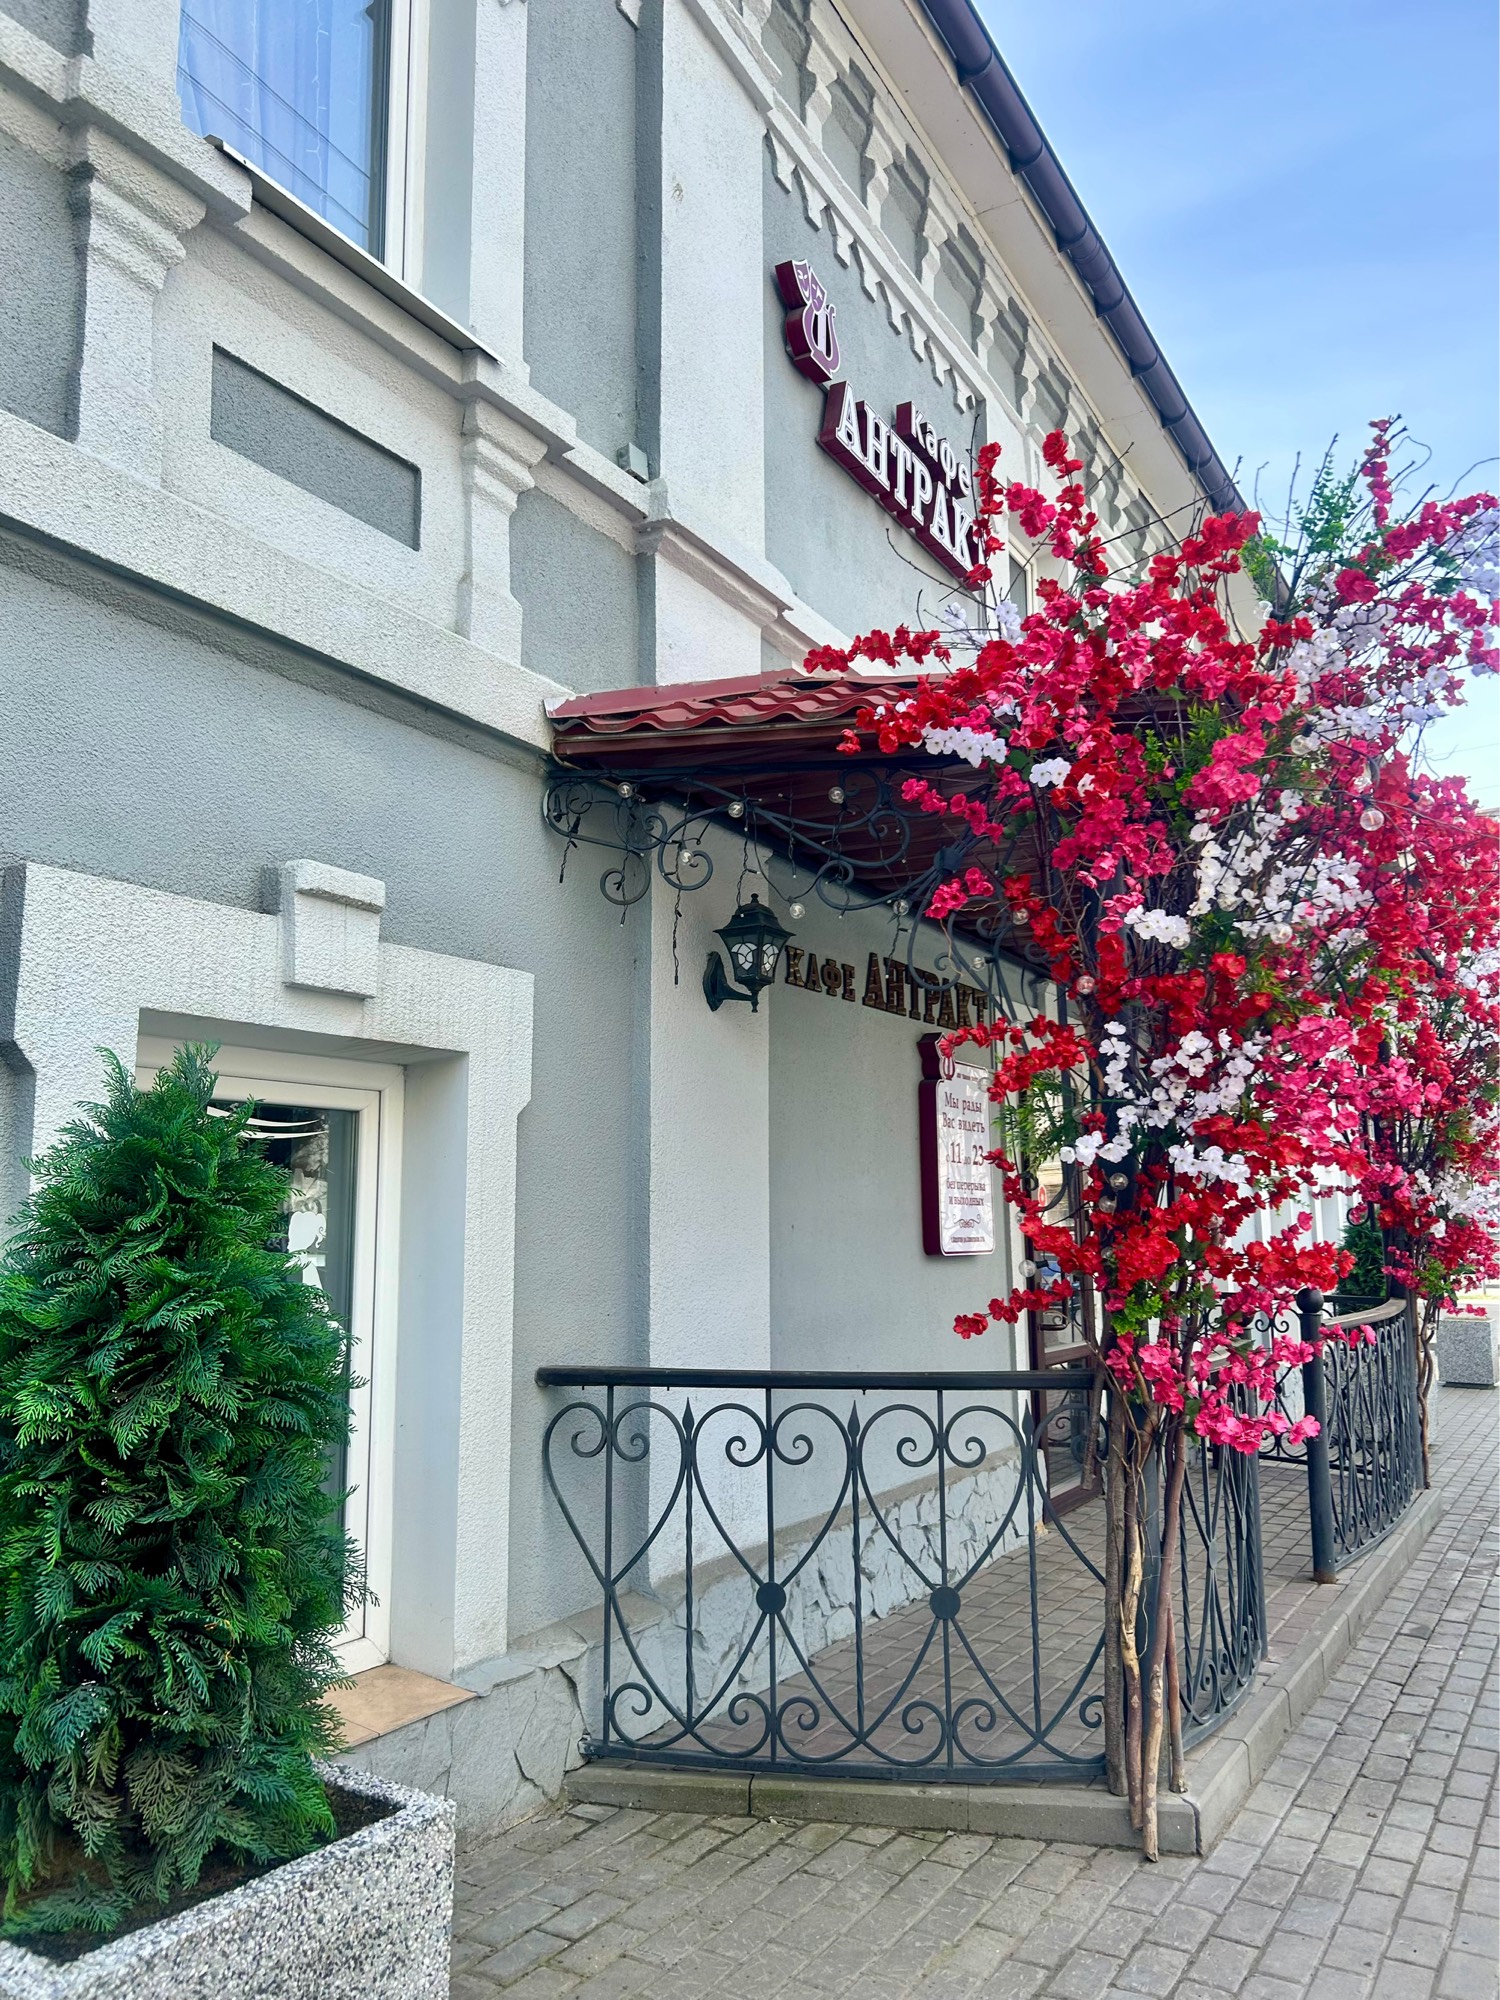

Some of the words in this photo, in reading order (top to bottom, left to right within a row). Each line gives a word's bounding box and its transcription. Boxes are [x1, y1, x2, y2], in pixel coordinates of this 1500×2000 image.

[910, 403, 971, 497] кафе
[785, 945, 855, 1002] КАФЕ
[862, 952, 989, 1030] АНТРАКТ
[944, 1092, 959, 1109] Мы
[962, 1099, 982, 1114] рады
[942, 1112, 955, 1128] Вас
[958, 1118, 985, 1133] видеть
[950, 1142, 962, 1164] 11
[972, 1144, 984, 1167] 23
[946, 1177, 955, 1190] без
[957, 1181, 986, 1194] перерыва
[954, 1196, 984, 1206] выходных
